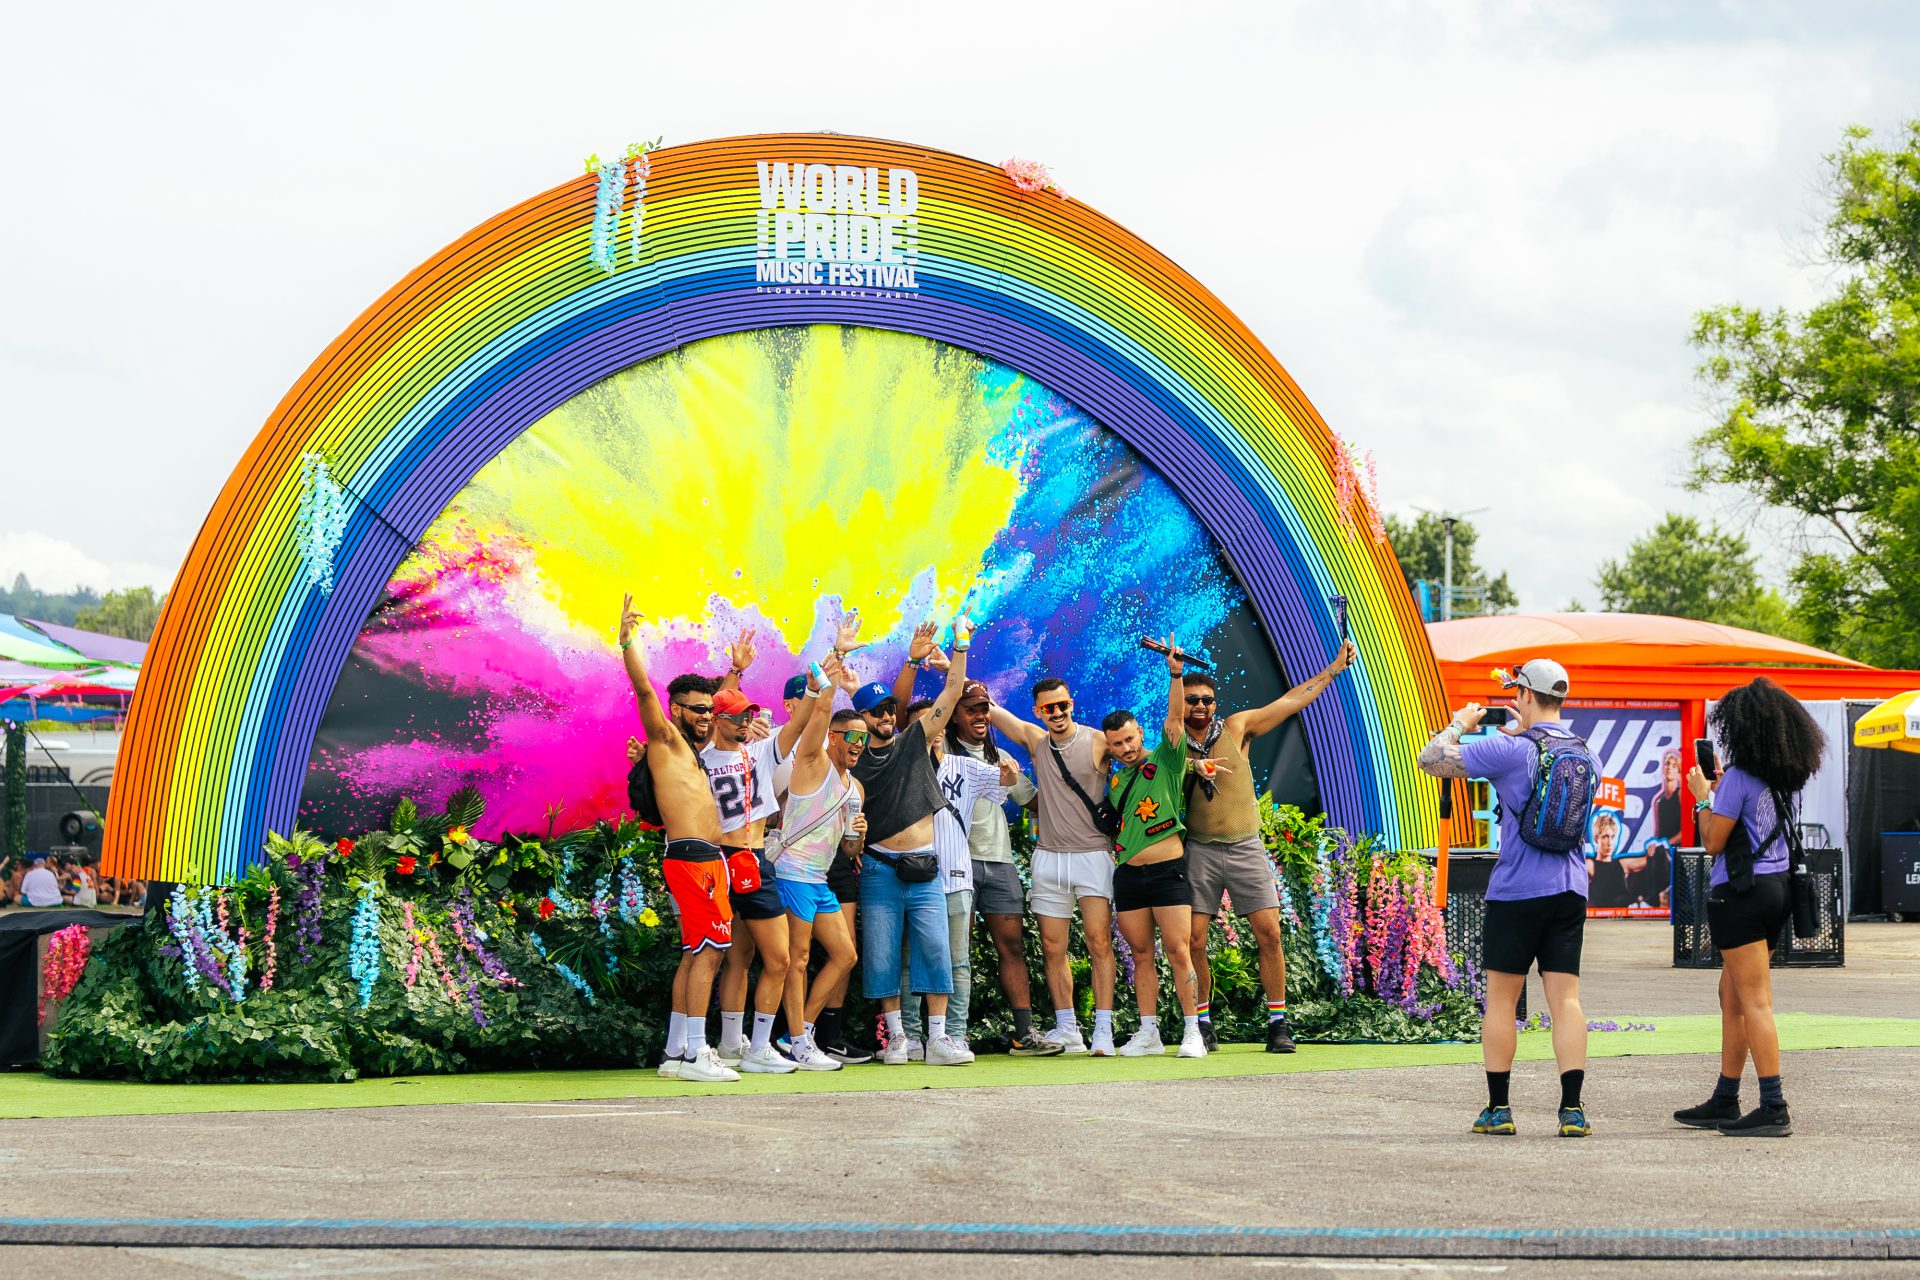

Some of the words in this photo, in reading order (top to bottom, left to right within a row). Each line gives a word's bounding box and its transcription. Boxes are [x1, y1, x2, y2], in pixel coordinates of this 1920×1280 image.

[757, 161, 919, 216] WORLD
[775, 212, 904, 263] PRIDE
[756, 259, 823, 285] MUSIC
[829, 262, 919, 288] FESTIVAL
[757, 286, 810, 295] GLOBAL
[821, 289, 866, 298] DANCE
[876, 291, 919, 299] PARTY
[708, 756, 757, 776] CALIFORIA
[942, 773, 965, 801] NY
[1147, 820, 1174, 834] RESPECT
[1905, 873, 1920, 885] LE
